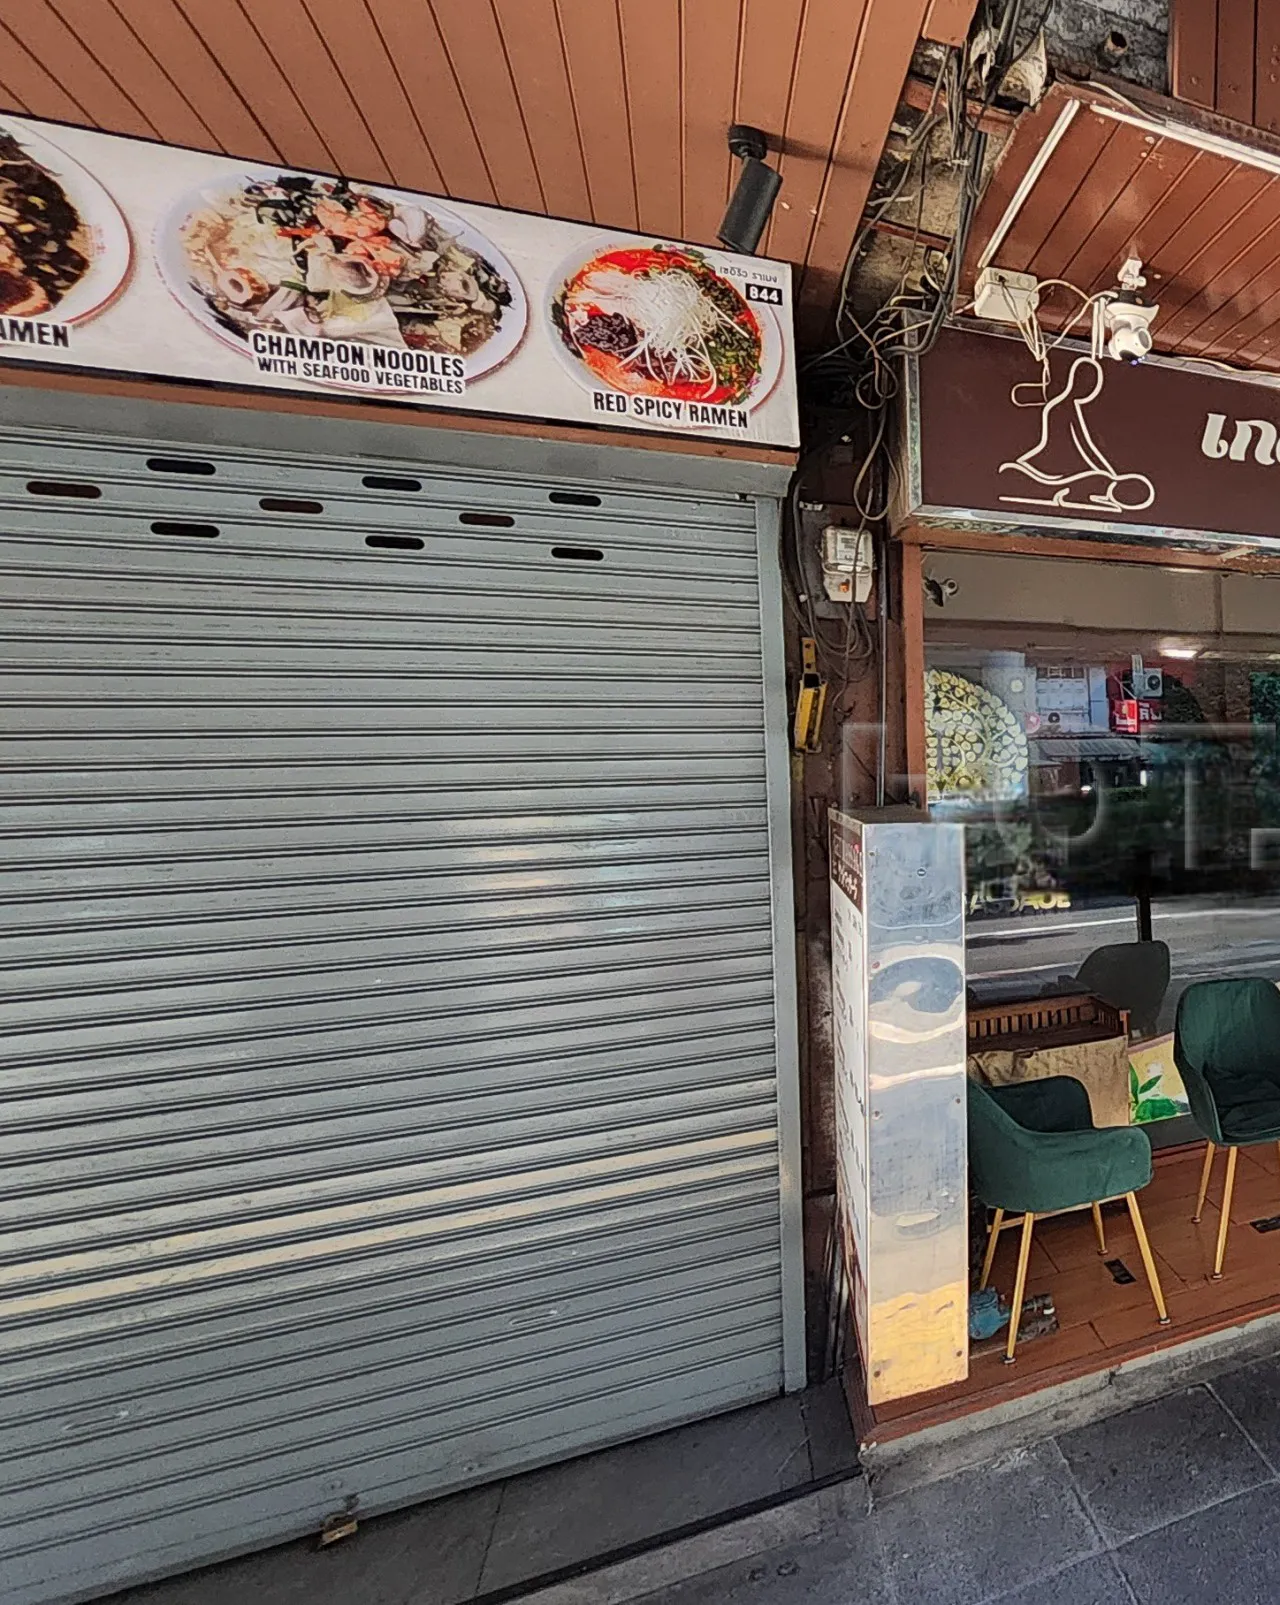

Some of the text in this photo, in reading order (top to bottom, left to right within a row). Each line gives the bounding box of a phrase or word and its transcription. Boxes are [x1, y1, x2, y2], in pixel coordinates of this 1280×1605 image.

[749, 285, 779, 303] 844
[252, 332, 465, 378] CHAMPON NOODLES
[257, 356, 463, 394] WITH SEAFOOD VEGETABLES
[593, 391, 748, 429] RED SPICY RAMEN
